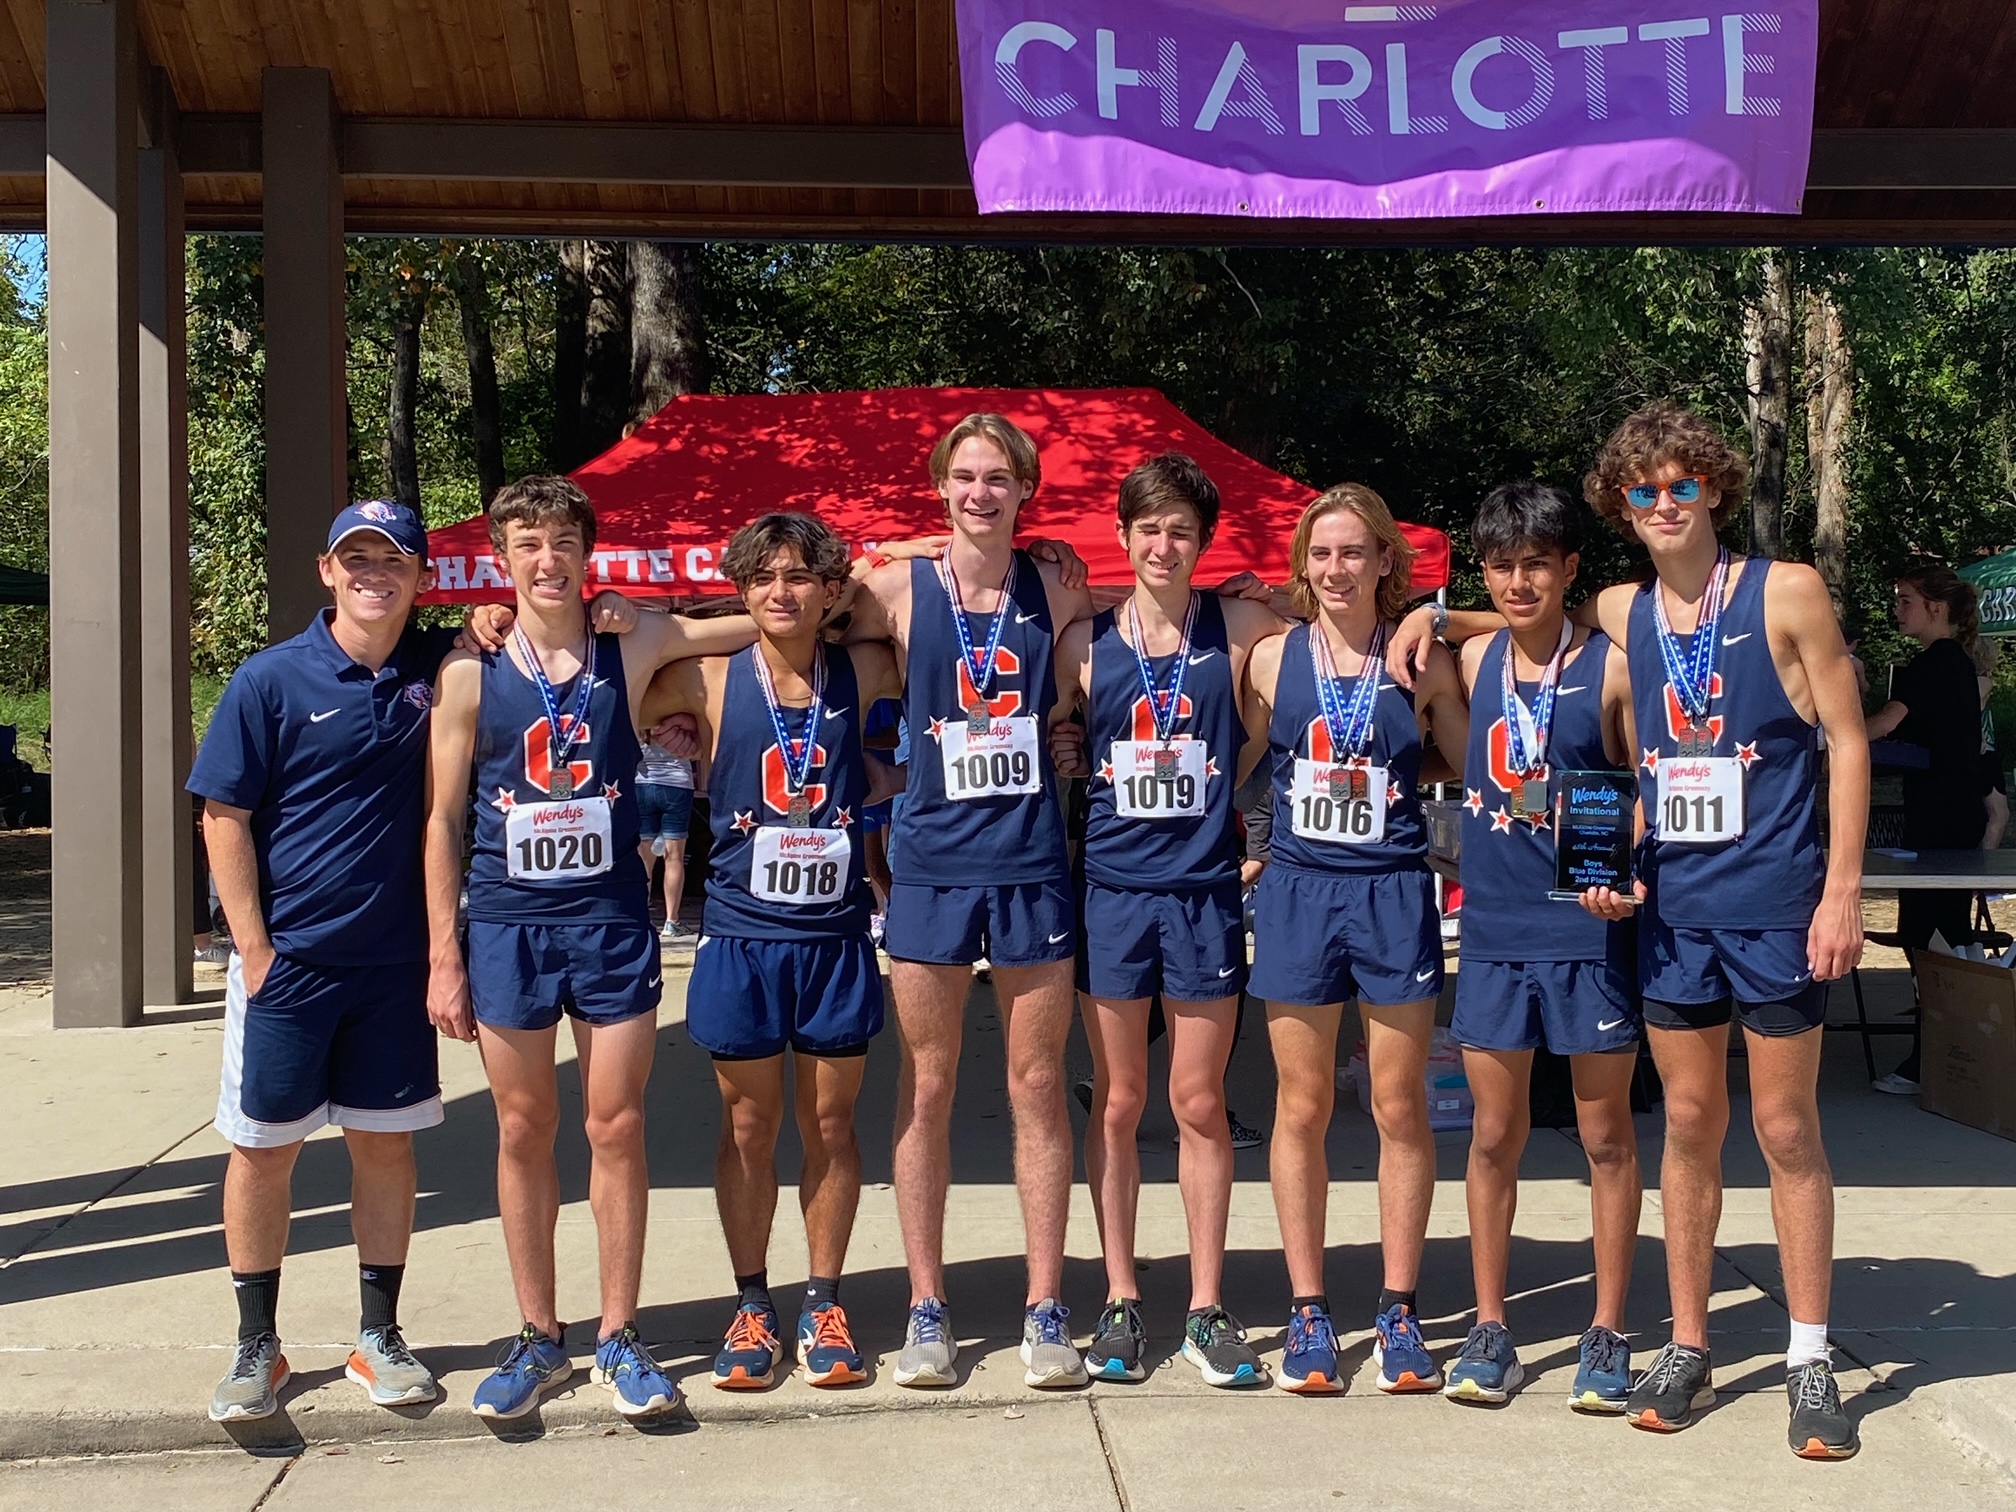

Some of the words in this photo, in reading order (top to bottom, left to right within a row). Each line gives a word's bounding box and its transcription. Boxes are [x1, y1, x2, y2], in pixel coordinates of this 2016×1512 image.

[995, 13, 1782, 136] CHARLOTTE
[428, 548, 675, 591] HATTE
[1136, 746, 1183, 763] We's
[952, 751, 1030, 790] 1009
[1668, 761, 1711, 782] Wendy's
[1122, 774, 1195, 809] 1019
[1572, 786, 1618, 805] Wendy's
[533, 803, 584, 826] Wendy's
[1301, 795, 1373, 836] 1016
[1570, 806, 1620, 816] Invitational
[1664, 795, 1724, 833] 1011
[516, 832, 603, 872] 1020
[780, 831, 826, 851] Wendy's
[763, 860, 838, 896] 1018
[1569, 867, 1586, 875] Blue
[1587, 868, 1618, 876] Division
[1584, 859, 1603, 868] Boys
